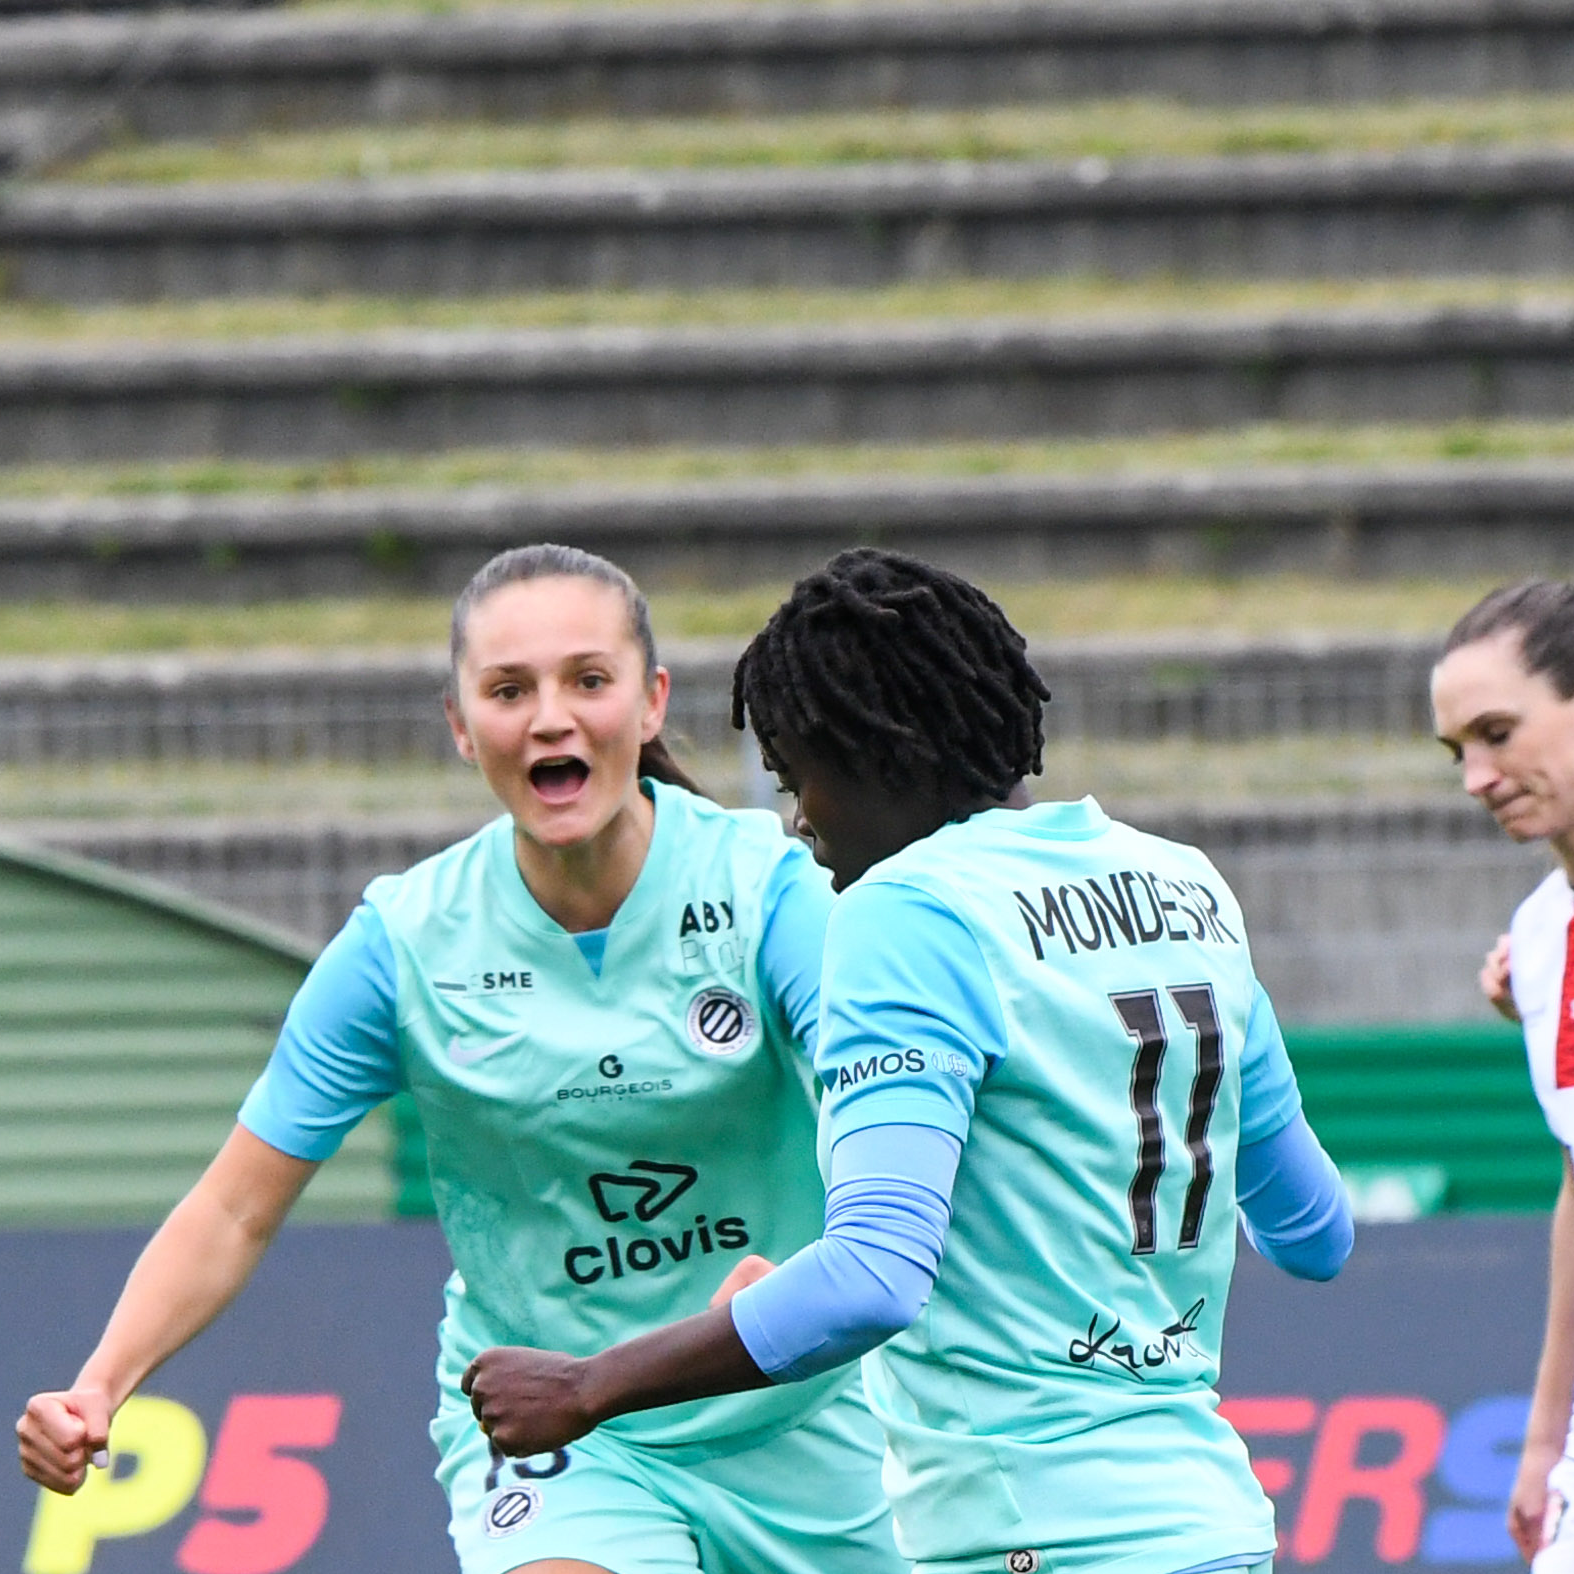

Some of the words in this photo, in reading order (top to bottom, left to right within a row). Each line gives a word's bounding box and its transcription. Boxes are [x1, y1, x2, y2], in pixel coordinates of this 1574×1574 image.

[679, 899, 735, 938] ABY
[1012, 870, 1240, 961] MONDESIR
[482, 971, 534, 990] SME
[838, 1048, 925, 1093] AMOS
[1107, 982, 1226, 1256] 11
